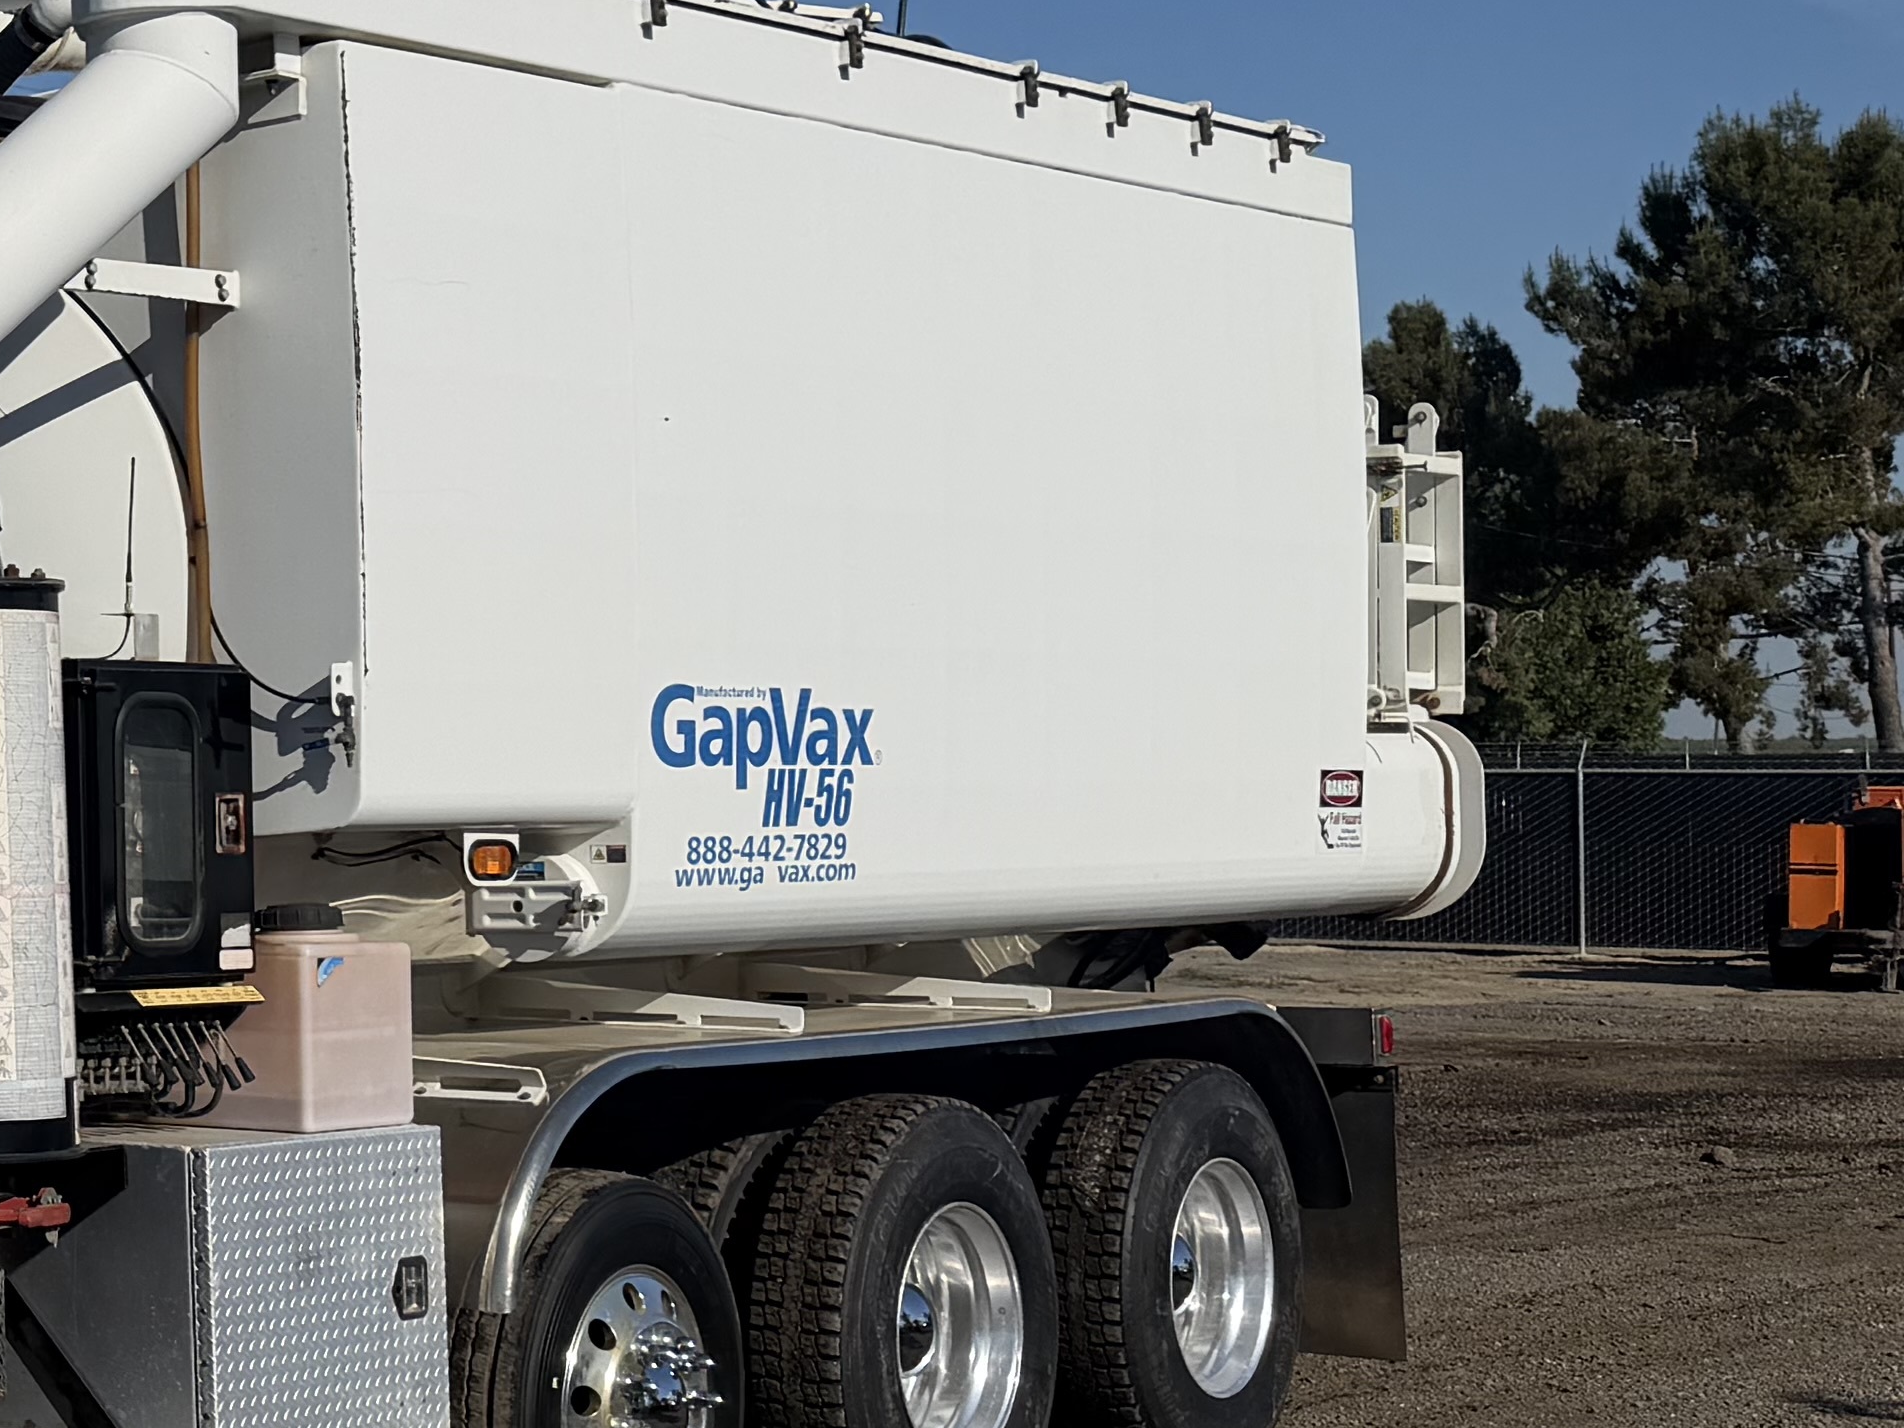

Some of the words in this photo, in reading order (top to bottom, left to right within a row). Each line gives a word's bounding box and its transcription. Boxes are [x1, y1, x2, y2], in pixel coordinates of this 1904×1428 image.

[696, 685, 755, 698] Manufactured
[757, 686, 767, 701] by
[650, 683, 875, 790] GapVax
[761, 768, 854, 828] HV-56
[686, 832, 848, 866] 888-442-7829
